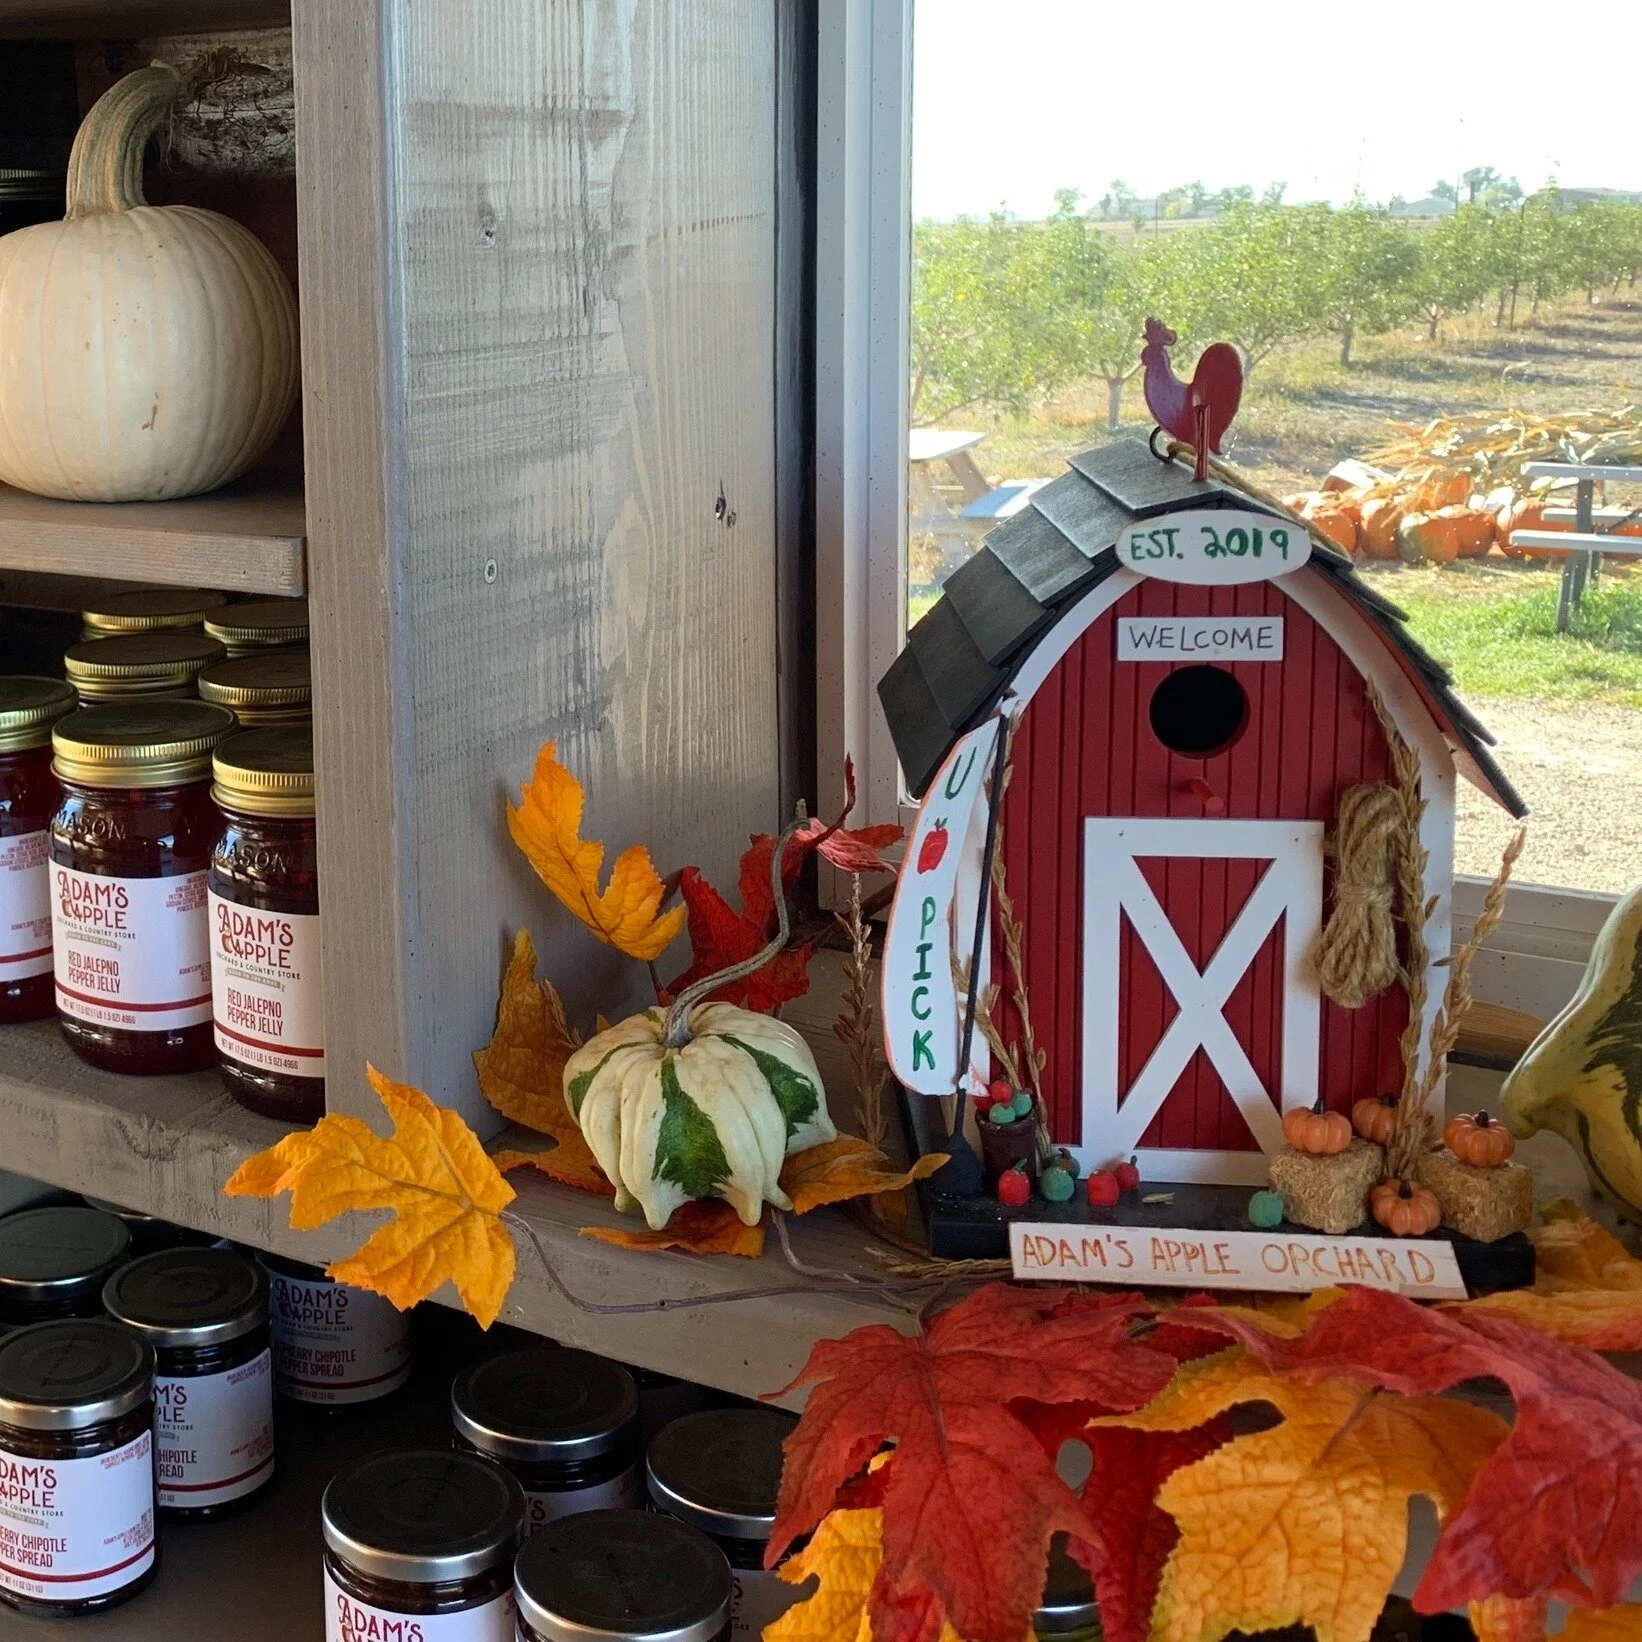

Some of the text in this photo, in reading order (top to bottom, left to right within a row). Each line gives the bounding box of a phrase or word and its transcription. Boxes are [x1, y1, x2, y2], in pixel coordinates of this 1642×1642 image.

[1131, 526, 1288, 560] EST. 2019
[1129, 625, 1274, 651] WELCOME
[57, 870, 129, 909] ADAM'S
[63, 899, 127, 930] APPLE
[911, 746, 977, 1071] U PICK
[114, 931, 137, 940] STORE
[217, 903, 294, 947] ADAM'S
[68, 949, 119, 977] RED JALEPNO
[222, 933, 292, 970] APPLE
[68, 966, 121, 994] PEPPER JELLY
[245, 963, 275, 977] COUNTRY
[277, 970, 301, 980] STORE
[227, 987, 282, 1019] RED JALEPNO
[227, 1005, 284, 1037] PEPPER JELLY
[1022, 1233, 1436, 1285] ADAM'S APPLE ORCHARD
[275, 1278, 349, 1308] ADAM'S
[310, 1362, 344, 1377] SPREAD
[16, 1548, 53, 1568] SPREAD
[21, 1533, 68, 1553] CHIPOTLE
[337, 1594, 425, 1642] ADAM'S
